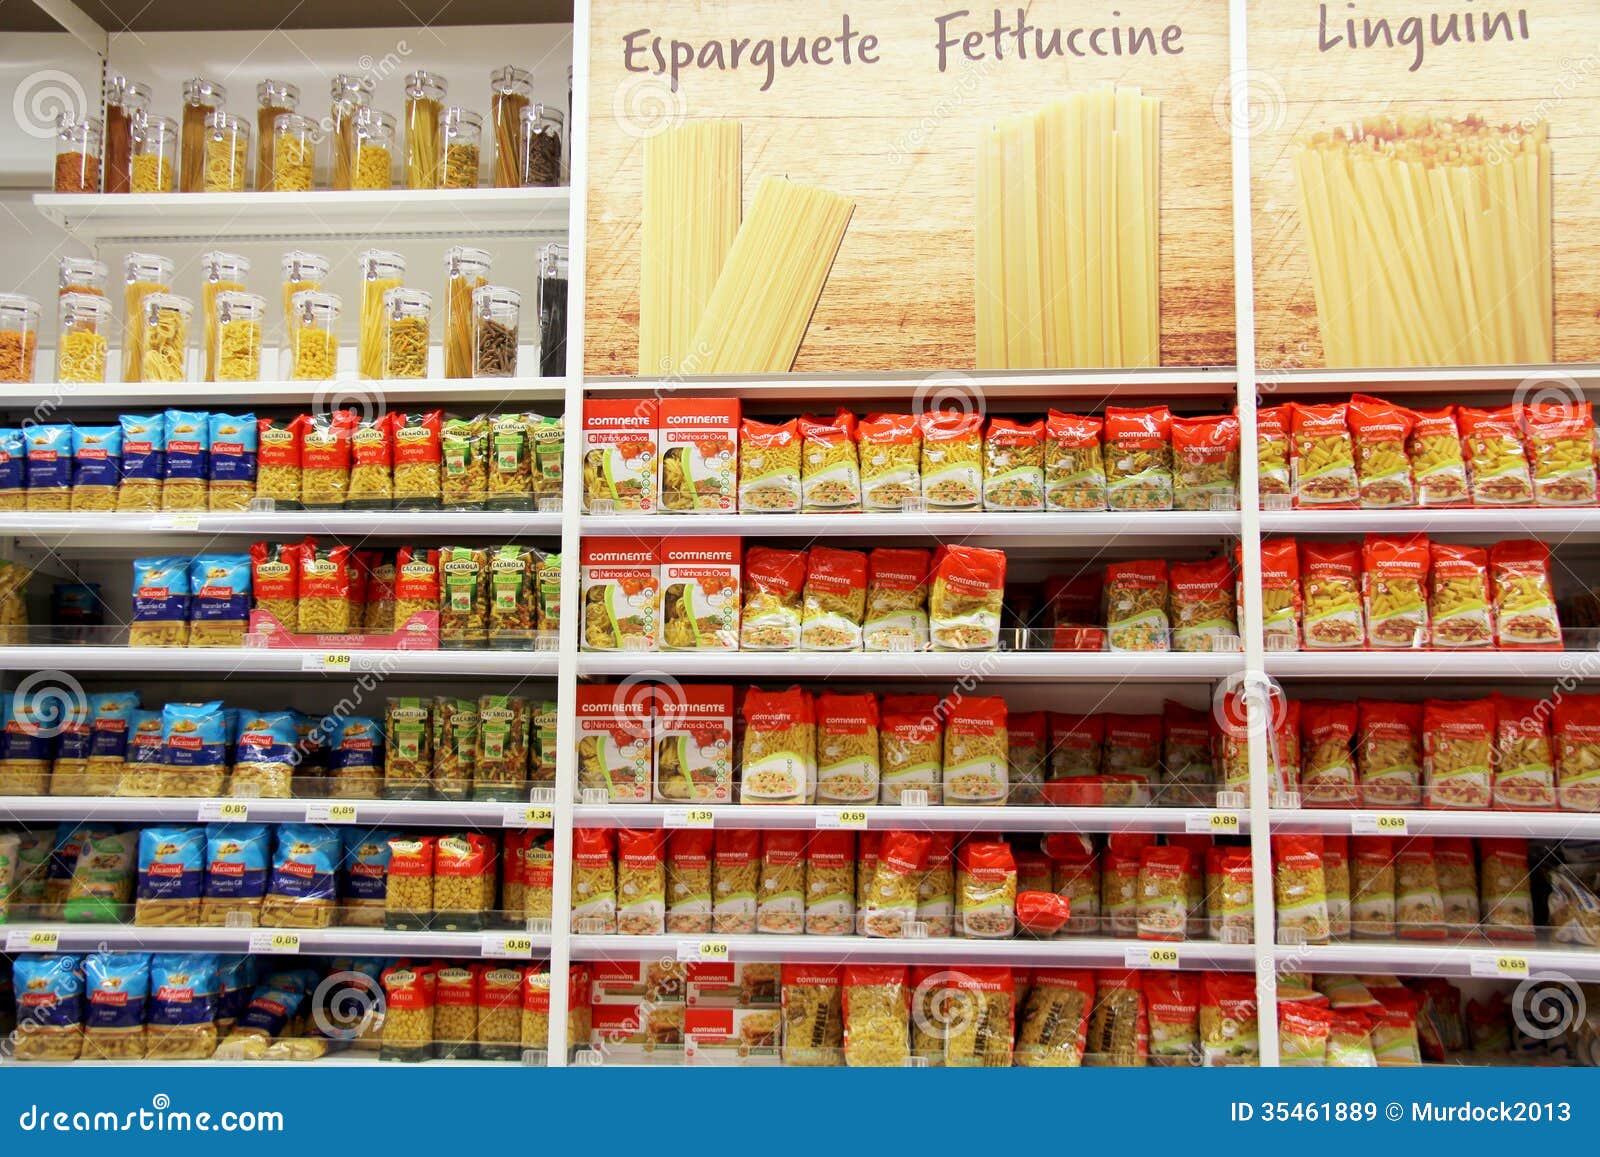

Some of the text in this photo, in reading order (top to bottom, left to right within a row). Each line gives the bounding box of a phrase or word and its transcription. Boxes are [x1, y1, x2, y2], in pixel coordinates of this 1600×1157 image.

[935, 9, 1184, 72] Fettuccine
[1318, 1, 1530, 72] Linguini
[623, 14, 880, 92] Esparguete
[588, 416, 650, 425] CONTINENTE
[666, 415, 729, 424] CONTINENTE
[678, 432, 727, 440] Ninhos de Ovos
[589, 552, 652, 561] CONTINENTE
[668, 551, 732, 560] CONTINENTE
[680, 569, 729, 577] Ninhos de Ovos
[875, 571, 917, 580] CONTINENTE
[809, 573, 851, 585] CONTINENTE
[949, 574, 990, 589] CONTINENTE
[328, 655, 350, 664] 0,89
[582, 703, 643, 712] CONTINENTE
[663, 703, 725, 712] CONTINENTE
[224, 804, 247, 814] 0,89
[333, 806, 355, 815] 0,89
[530, 810, 551, 820] 1,34
[691, 811, 713, 821] 1,39
[842, 812, 865, 821] 0,69
[1213, 815, 1237, 825] 0,89
[1380, 817, 1405, 827] 0,69
[508, 940, 531, 950] 0,89
[1152, 951, 1177, 961] 0,69
[1500, 959, 1526, 970] 0,69
[796, 976, 838, 984] CONTINENTE
